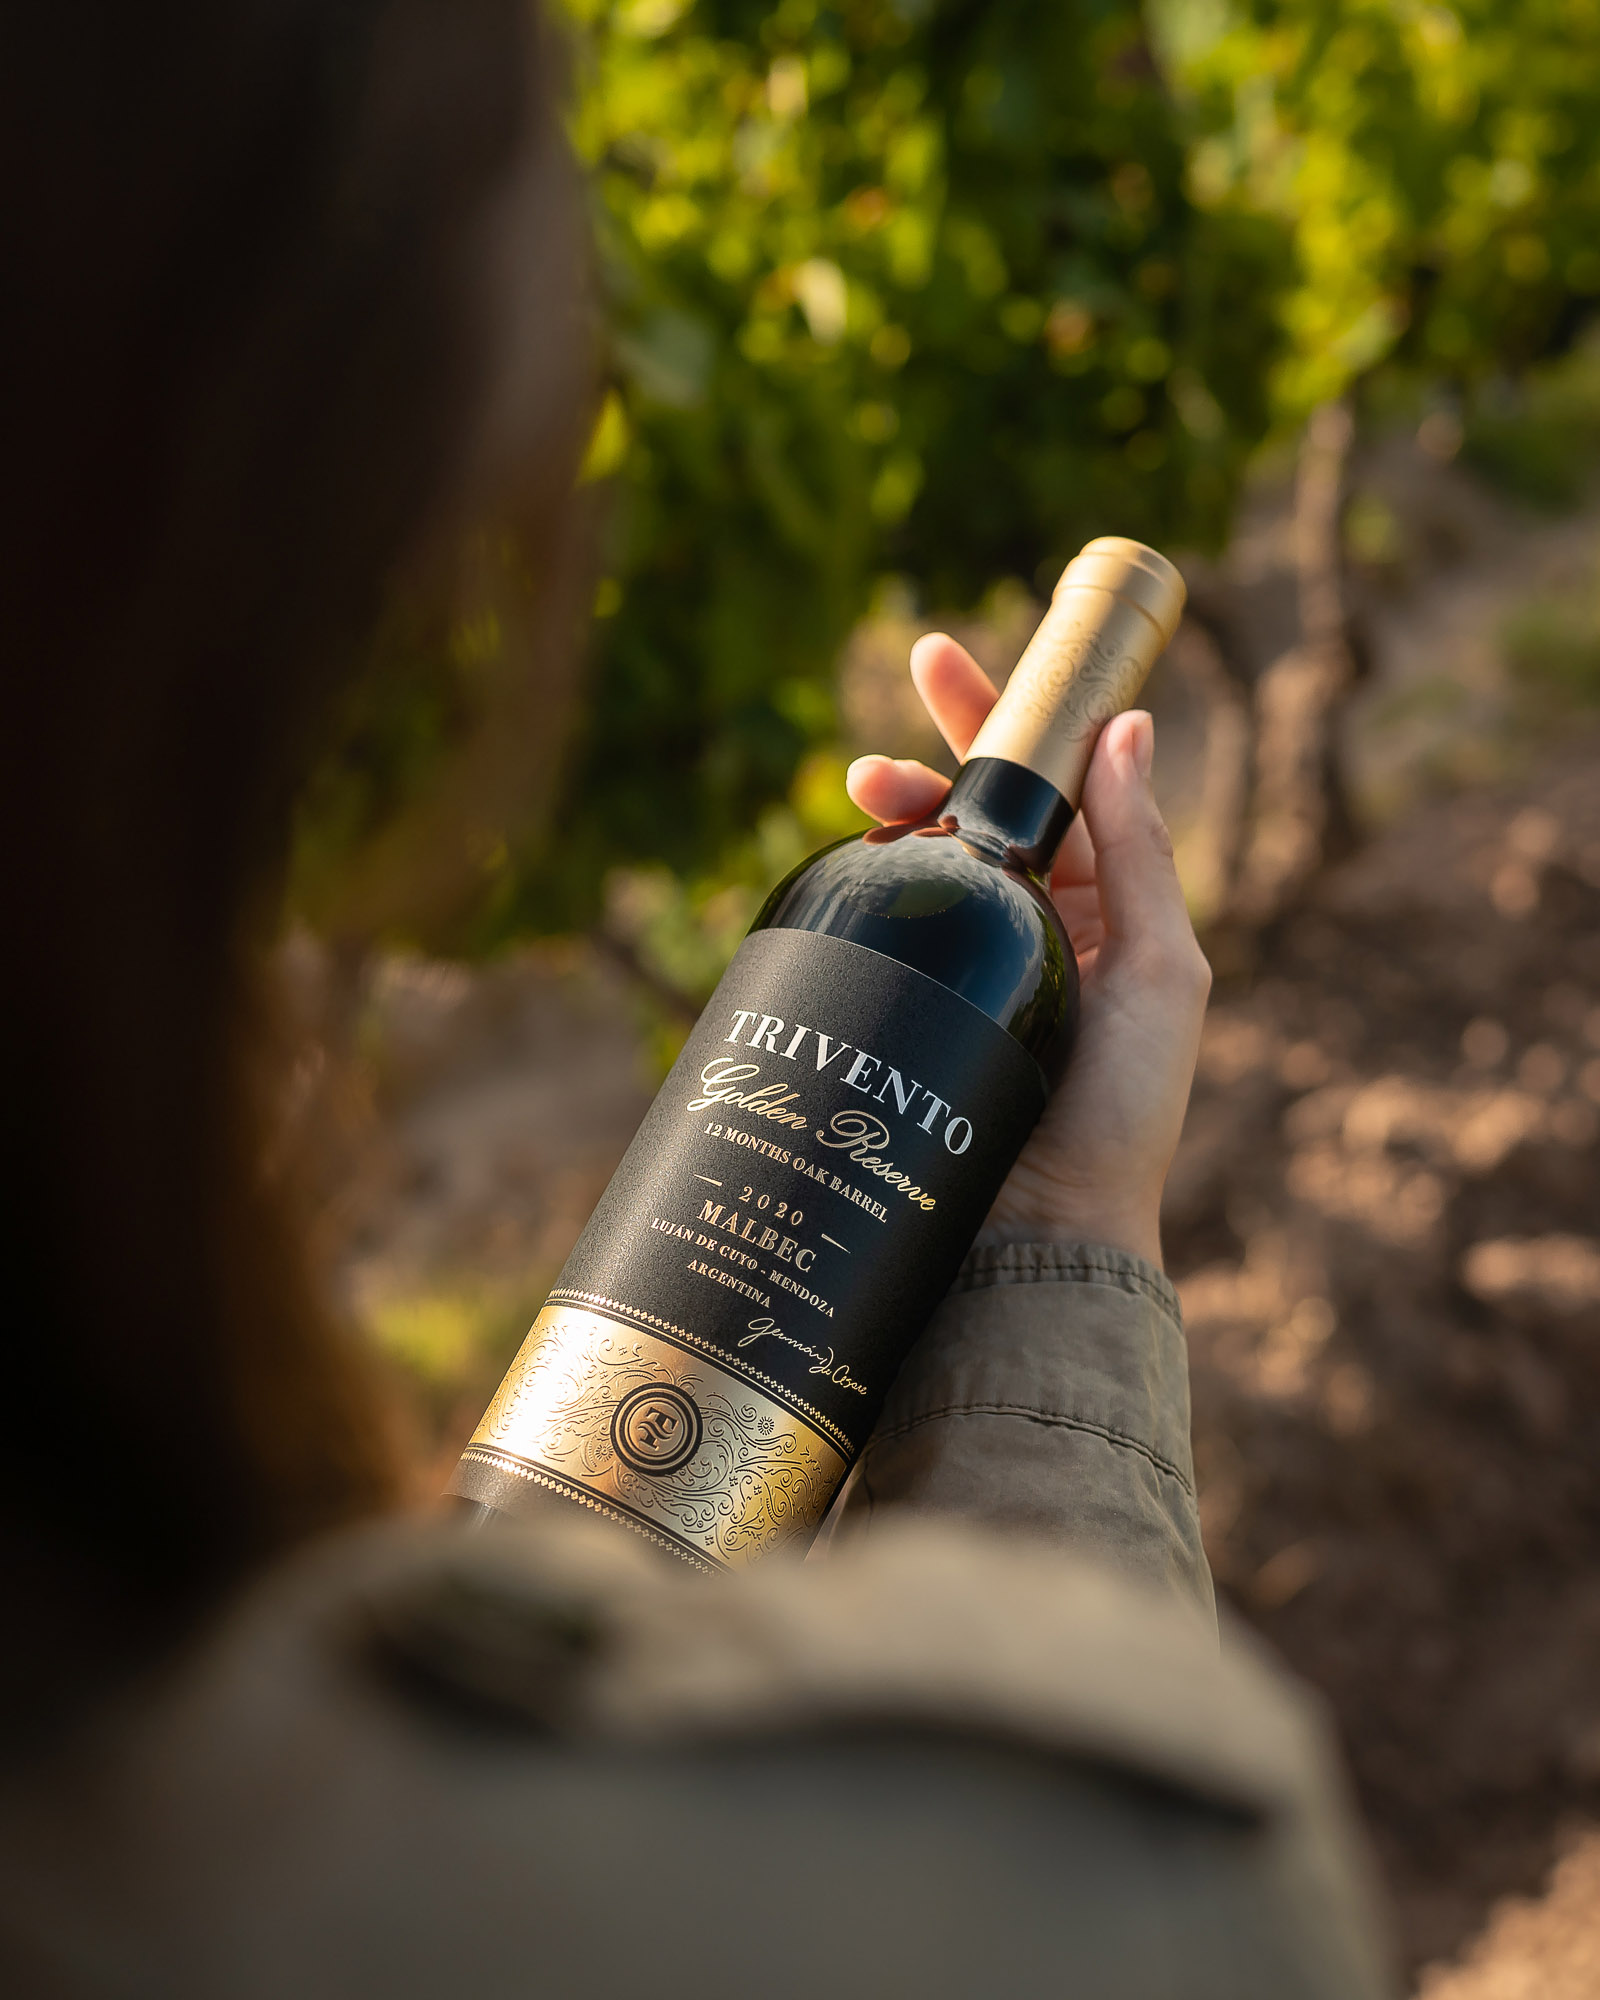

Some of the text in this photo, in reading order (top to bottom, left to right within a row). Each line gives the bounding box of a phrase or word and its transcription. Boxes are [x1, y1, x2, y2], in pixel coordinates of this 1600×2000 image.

[723, 1009, 974, 1156] TRIVENTO
[686, 1057, 937, 1212] Golden Reserve
[704, 1122, 889, 1224] 12 MONTHS OAK BARREL
[696, 1199, 817, 1273] MALBEC
[738, 1186, 804, 1226] 2020
[650, 1217, 695, 1242] LUJÁN
[694, 1233, 718, 1251] DE
[718, 1245, 758, 1270] CUYO
[767, 1269, 835, 1318] MENDOZA
[686, 1258, 771, 1309] ARGENTINA
